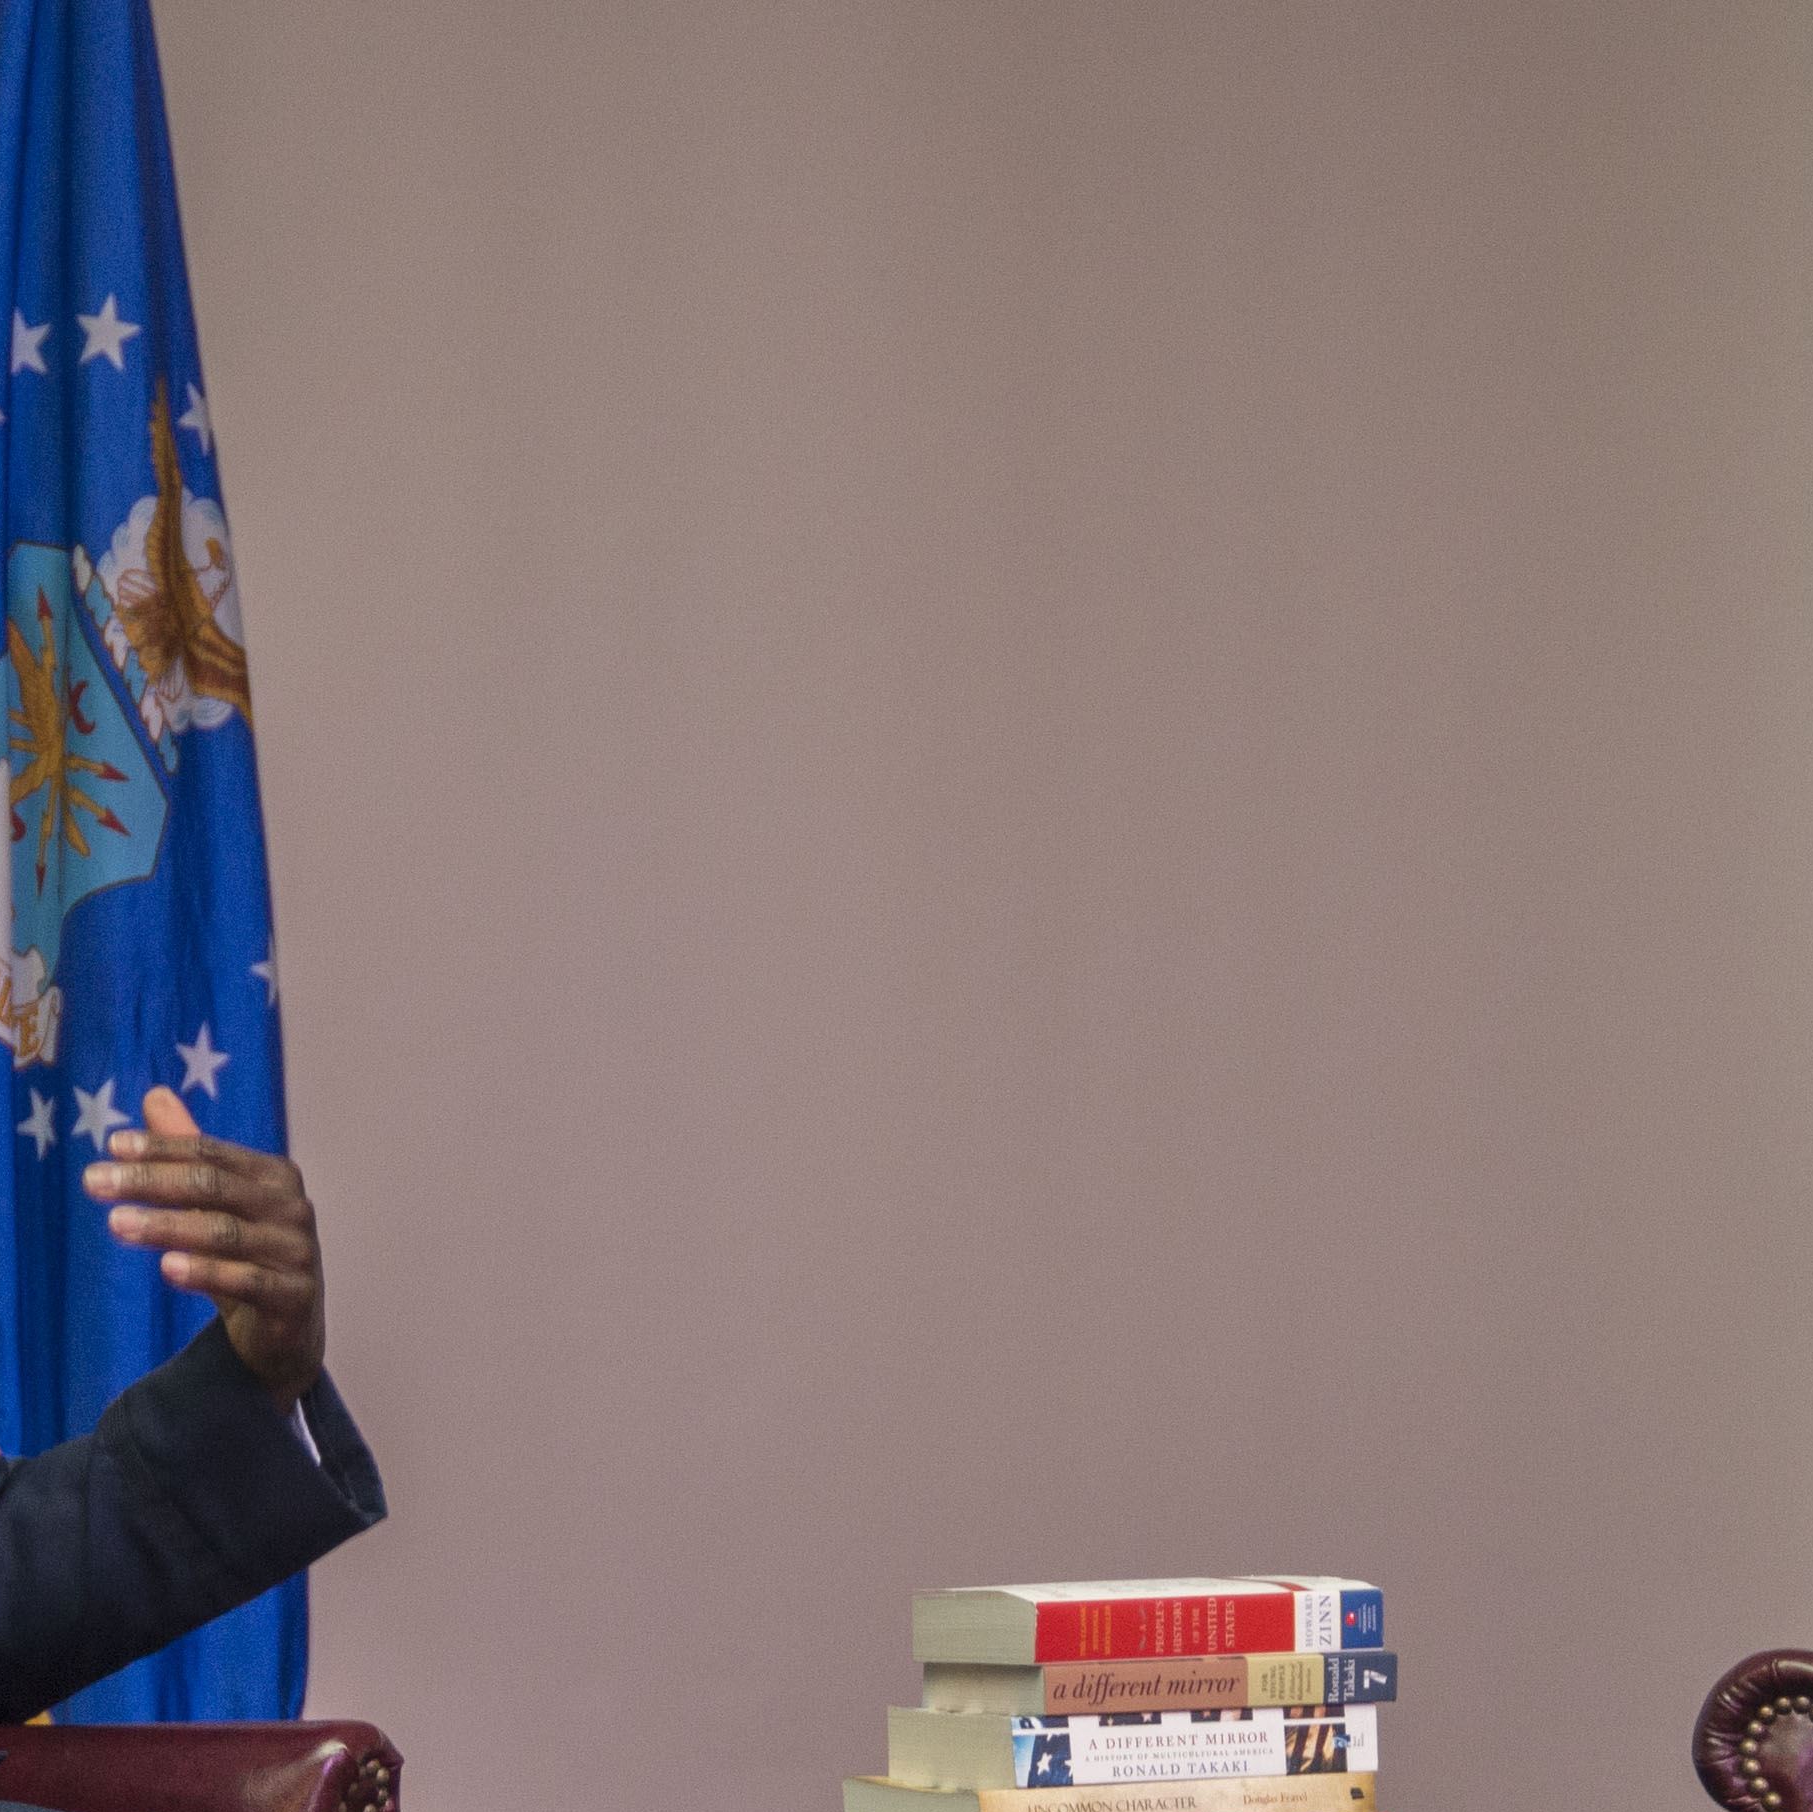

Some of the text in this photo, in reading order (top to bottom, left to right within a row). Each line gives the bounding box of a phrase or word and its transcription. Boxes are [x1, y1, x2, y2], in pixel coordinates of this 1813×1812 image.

[1172, 1601, 1182, 1653] HISTORY
[1208, 1598, 1217, 1651] UNITED
[1225, 1600, 1235, 1648] STATES
[1305, 1594, 1313, 1647] HOWARD
[1319, 1595, 1332, 1646] ZINN
[1053, 1670, 1241, 1705] a different mirror
[1328, 1657, 1339, 1702] Ronald
[1344, 1658, 1355, 1701] Takaki
[1089, 1731, 1269, 1750] A DIFFERENT MIRROR
[1093, 1754, 1133, 1763] HISTORY
[1153, 1750, 1229, 1759] MULTICULTURAL
[1233, 1748, 1274, 1757] AMERICA
[1112, 1760, 1249, 1777] RONALD TAKAKI
